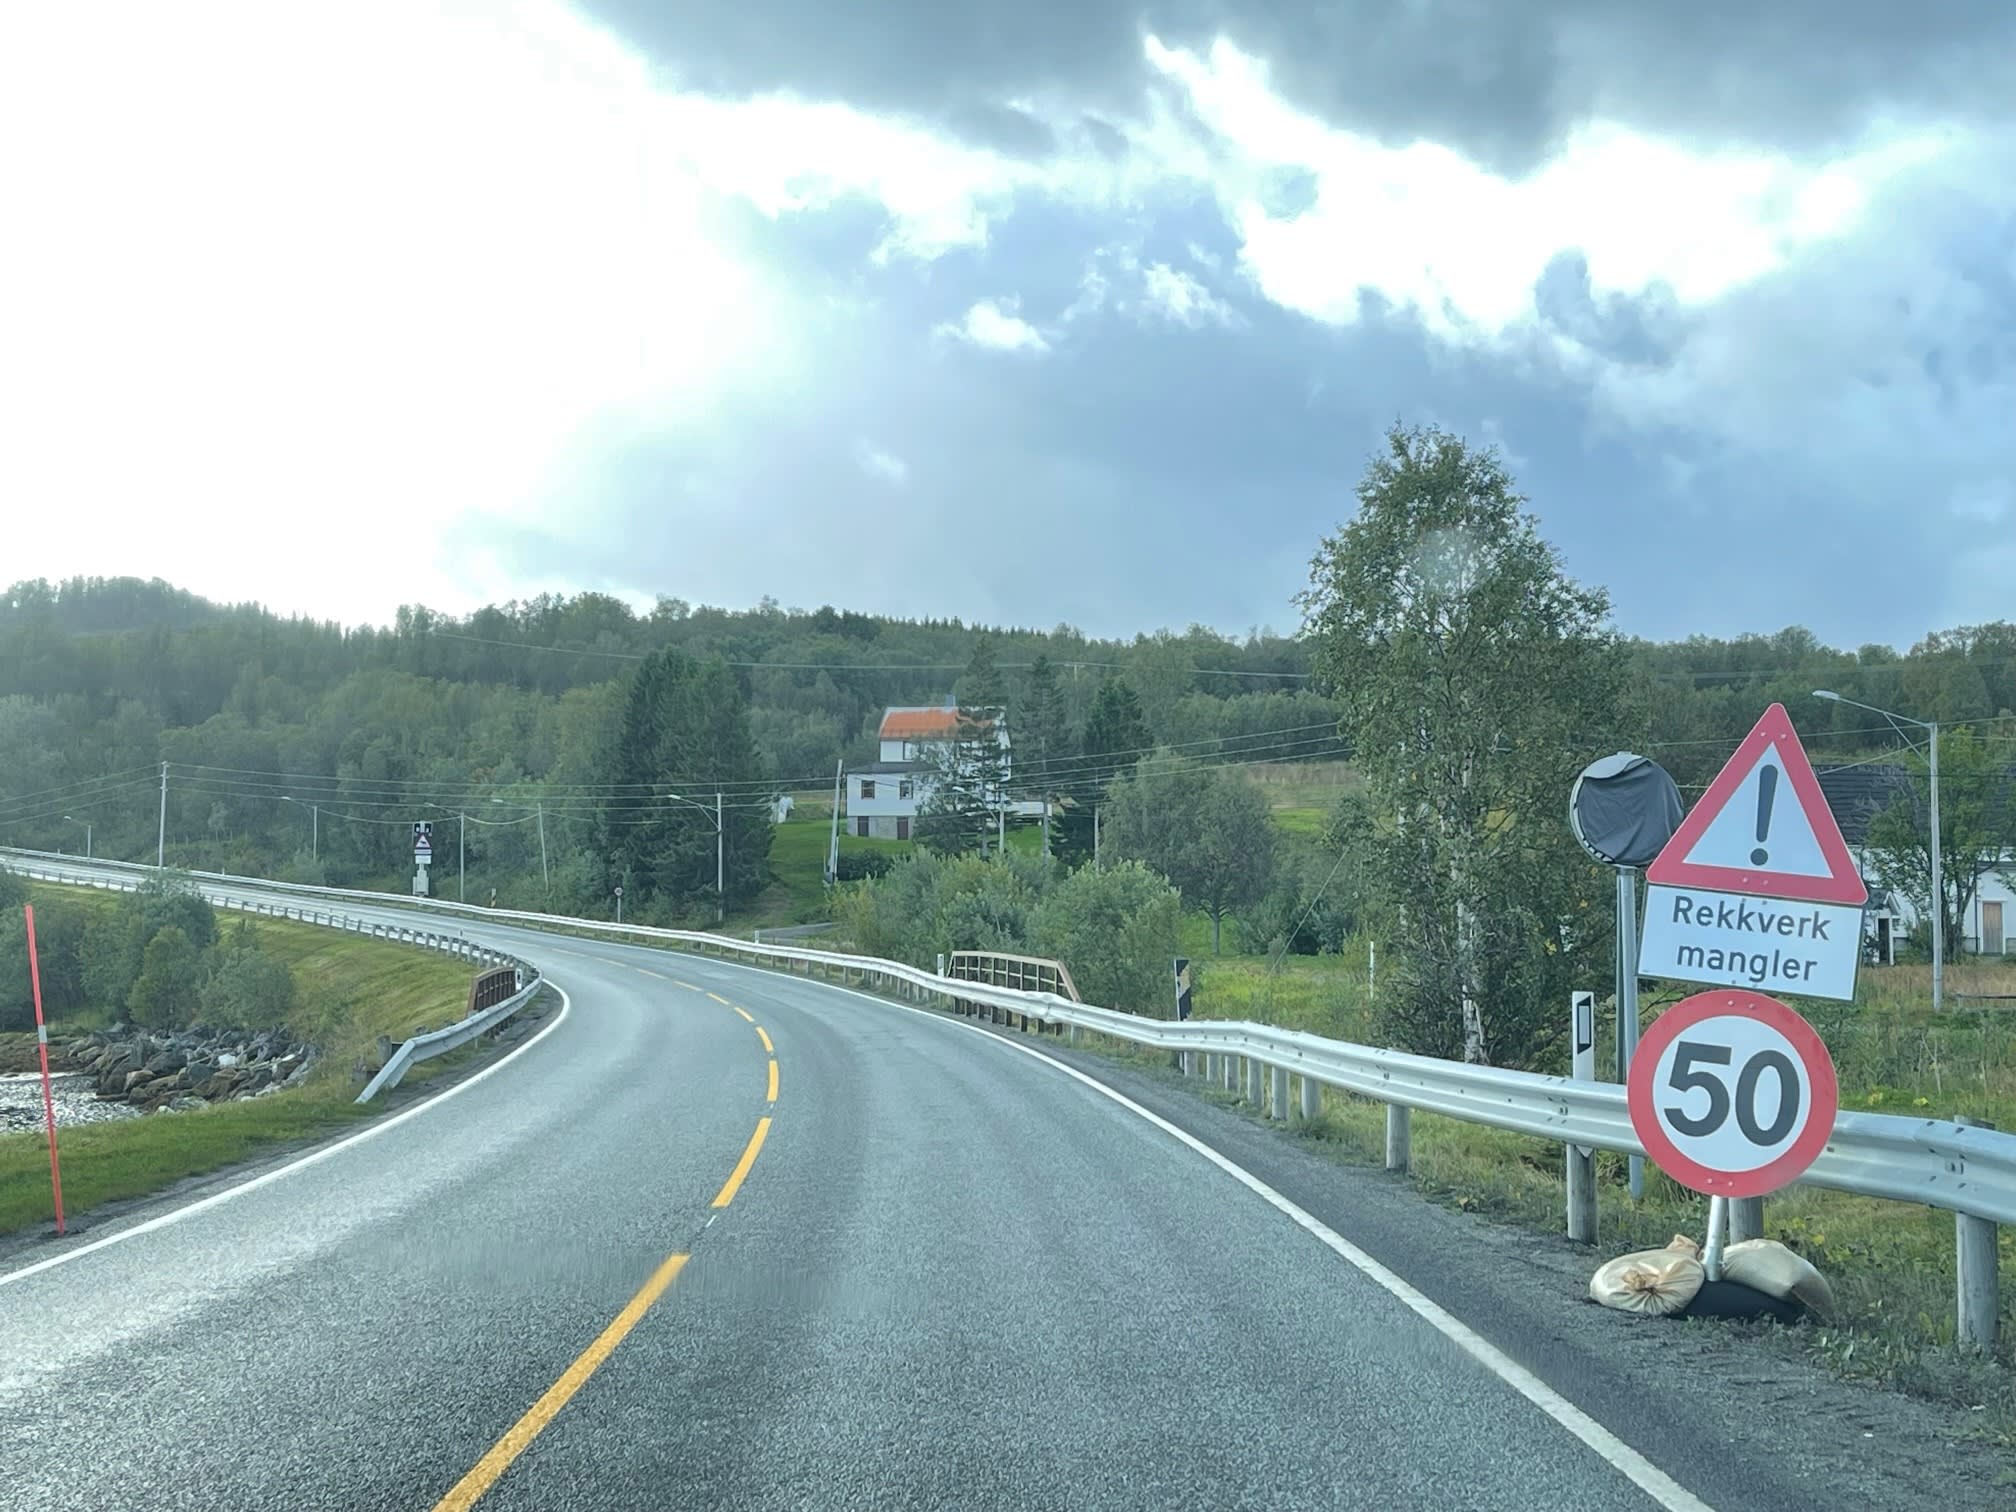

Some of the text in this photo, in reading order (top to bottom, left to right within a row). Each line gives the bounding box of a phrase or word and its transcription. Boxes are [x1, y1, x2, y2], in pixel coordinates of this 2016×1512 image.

[1673, 896, 1831, 941] Rekkverk
[1677, 943, 1818, 982] mangler
[1664, 1041, 1800, 1147] 50
